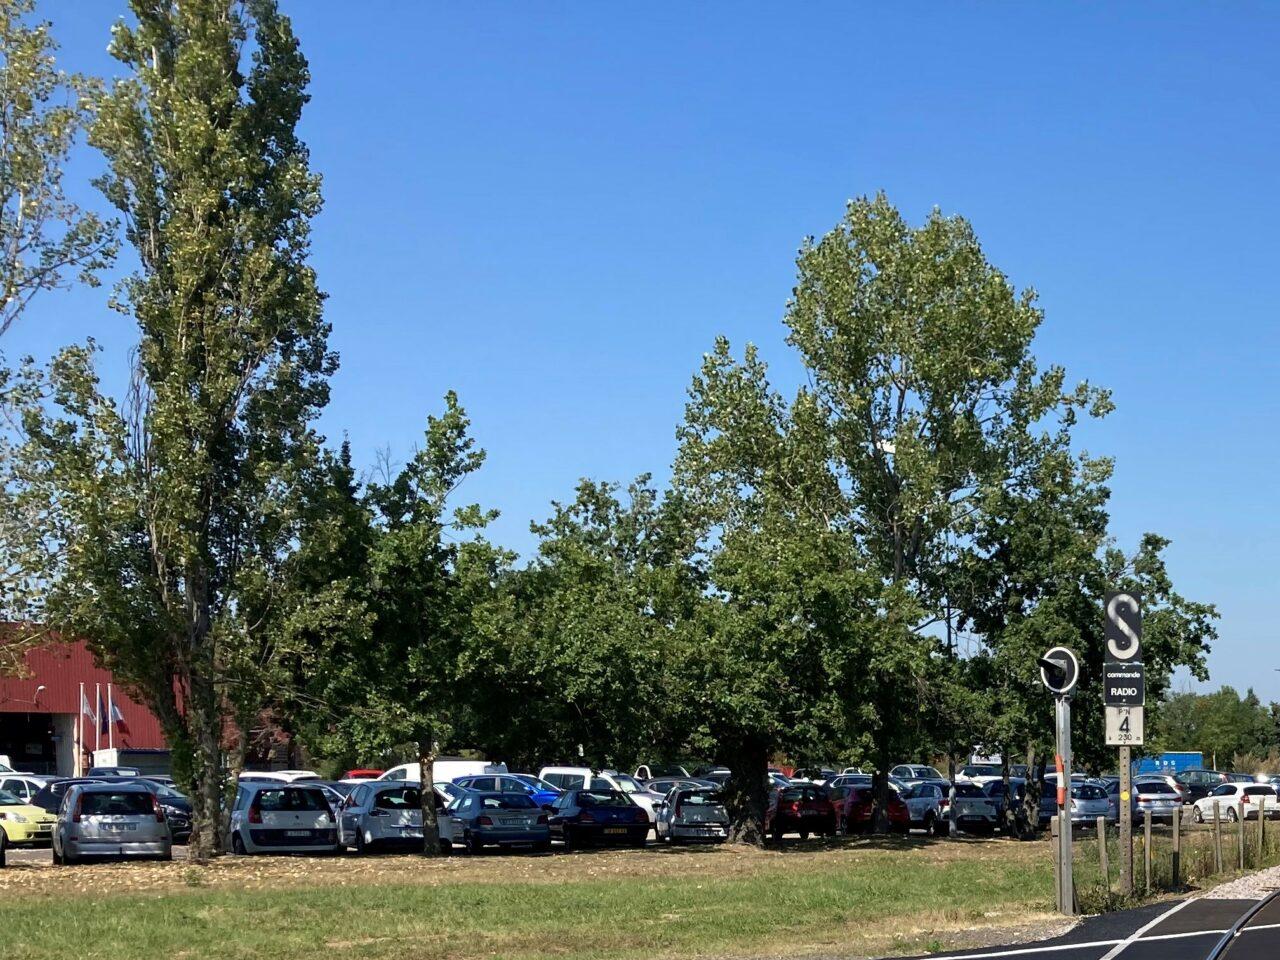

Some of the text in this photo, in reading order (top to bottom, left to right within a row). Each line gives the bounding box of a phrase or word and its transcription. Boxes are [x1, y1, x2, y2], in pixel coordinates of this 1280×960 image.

[1107, 593, 1139, 660] S
[1110, 687, 1137, 696] RADIO
[1119, 715, 1130, 733] 4
